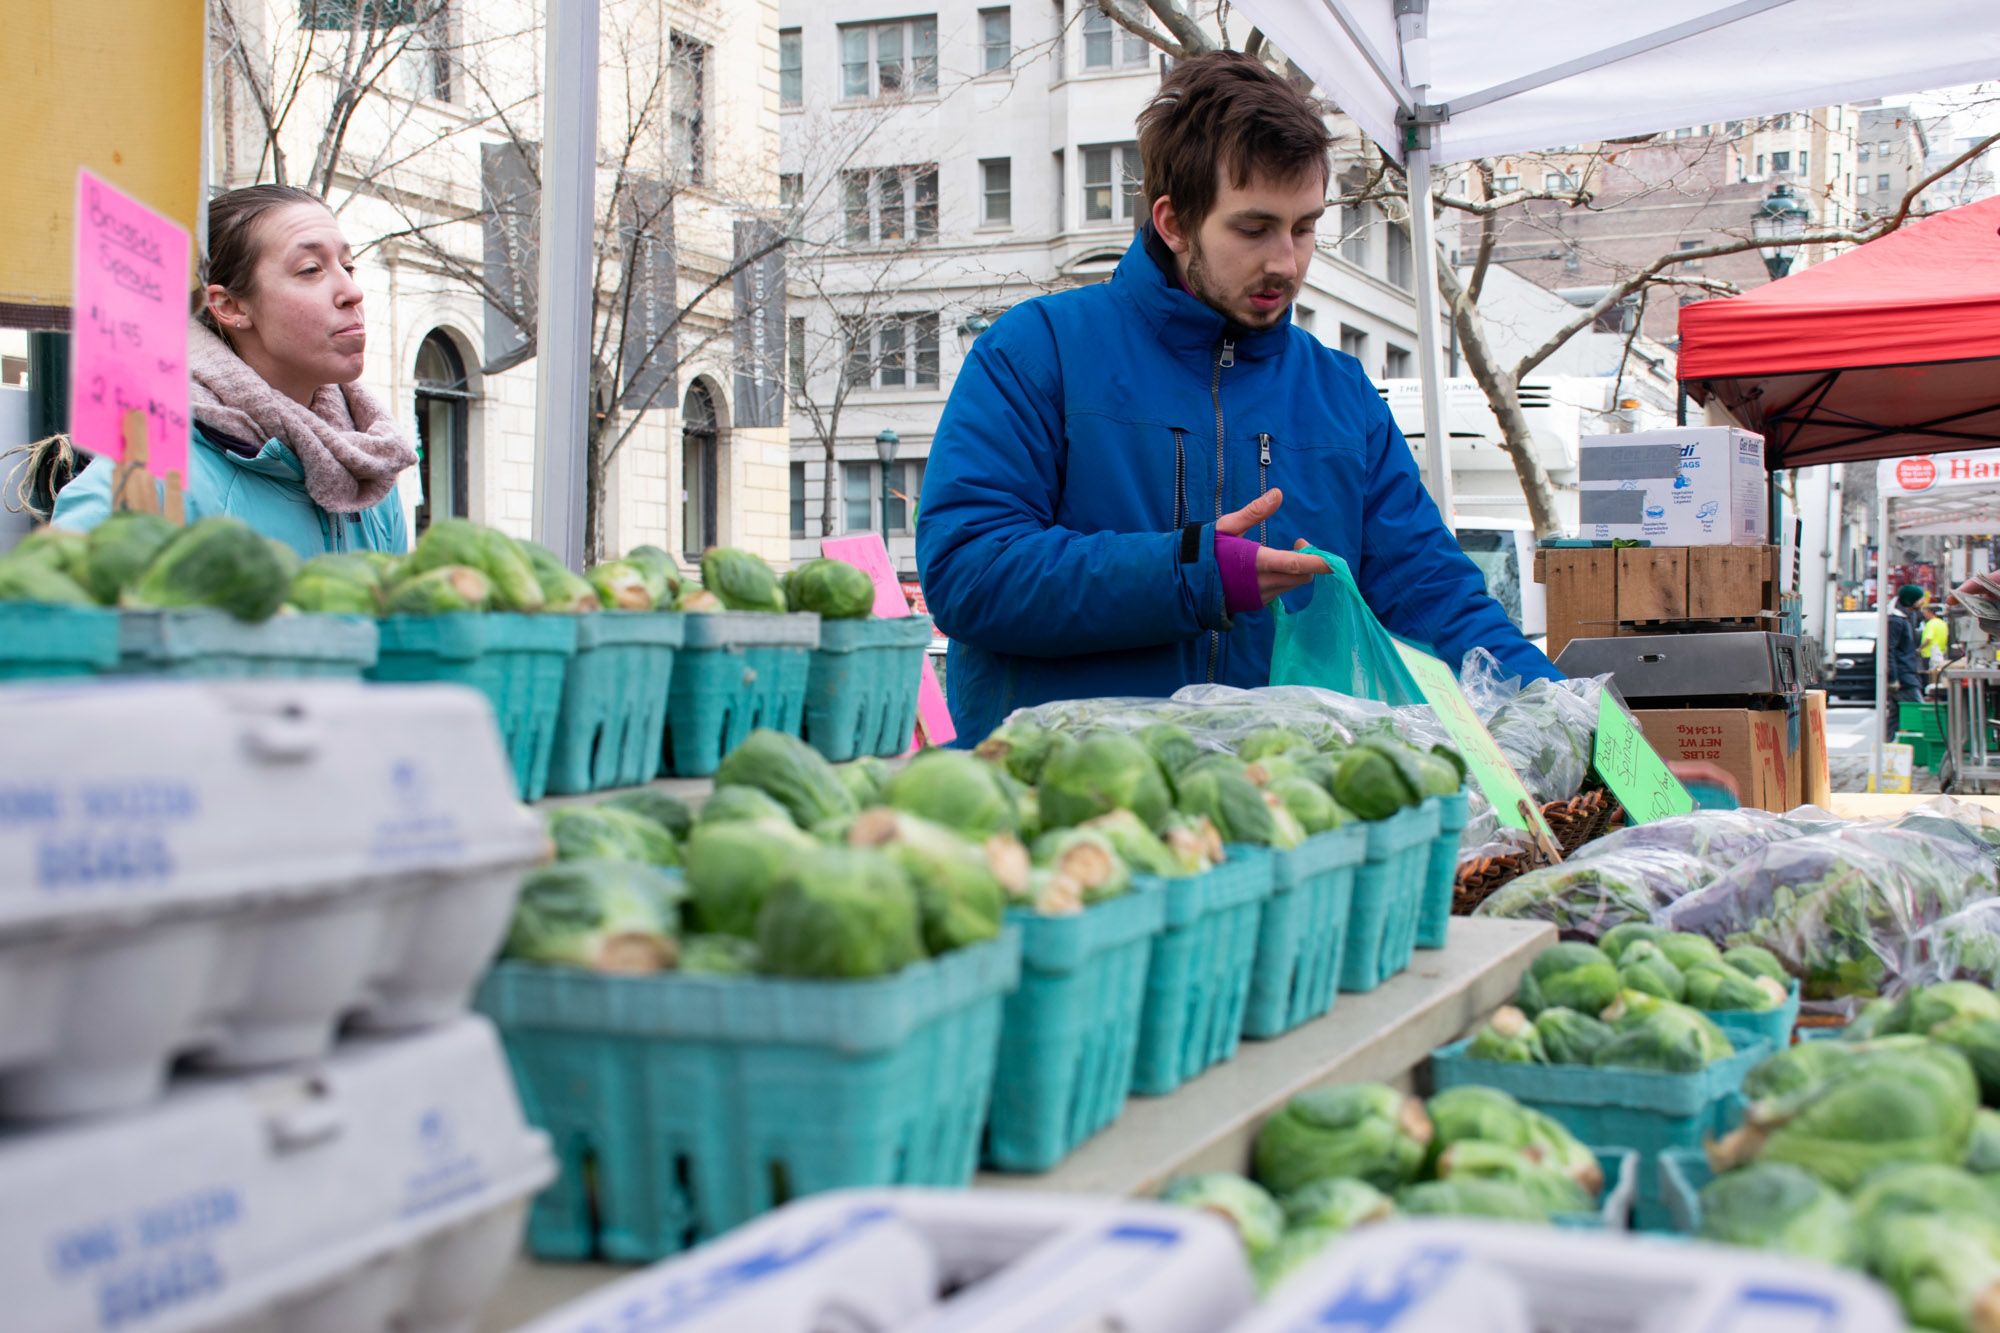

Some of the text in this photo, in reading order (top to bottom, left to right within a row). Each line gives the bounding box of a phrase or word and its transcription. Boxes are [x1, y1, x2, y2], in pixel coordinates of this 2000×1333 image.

[753, 261, 765, 388] ANTROPOOGIE
[91, 375, 106, 403] 2
[1678, 738, 1722, 747] NET WT.
[1695, 726, 1723, 735] 11.34
[1597, 731, 1622, 772] Baby
[1616, 721, 1634, 786] Spinach
[1680, 751, 1720, 759] 25 LBS.
